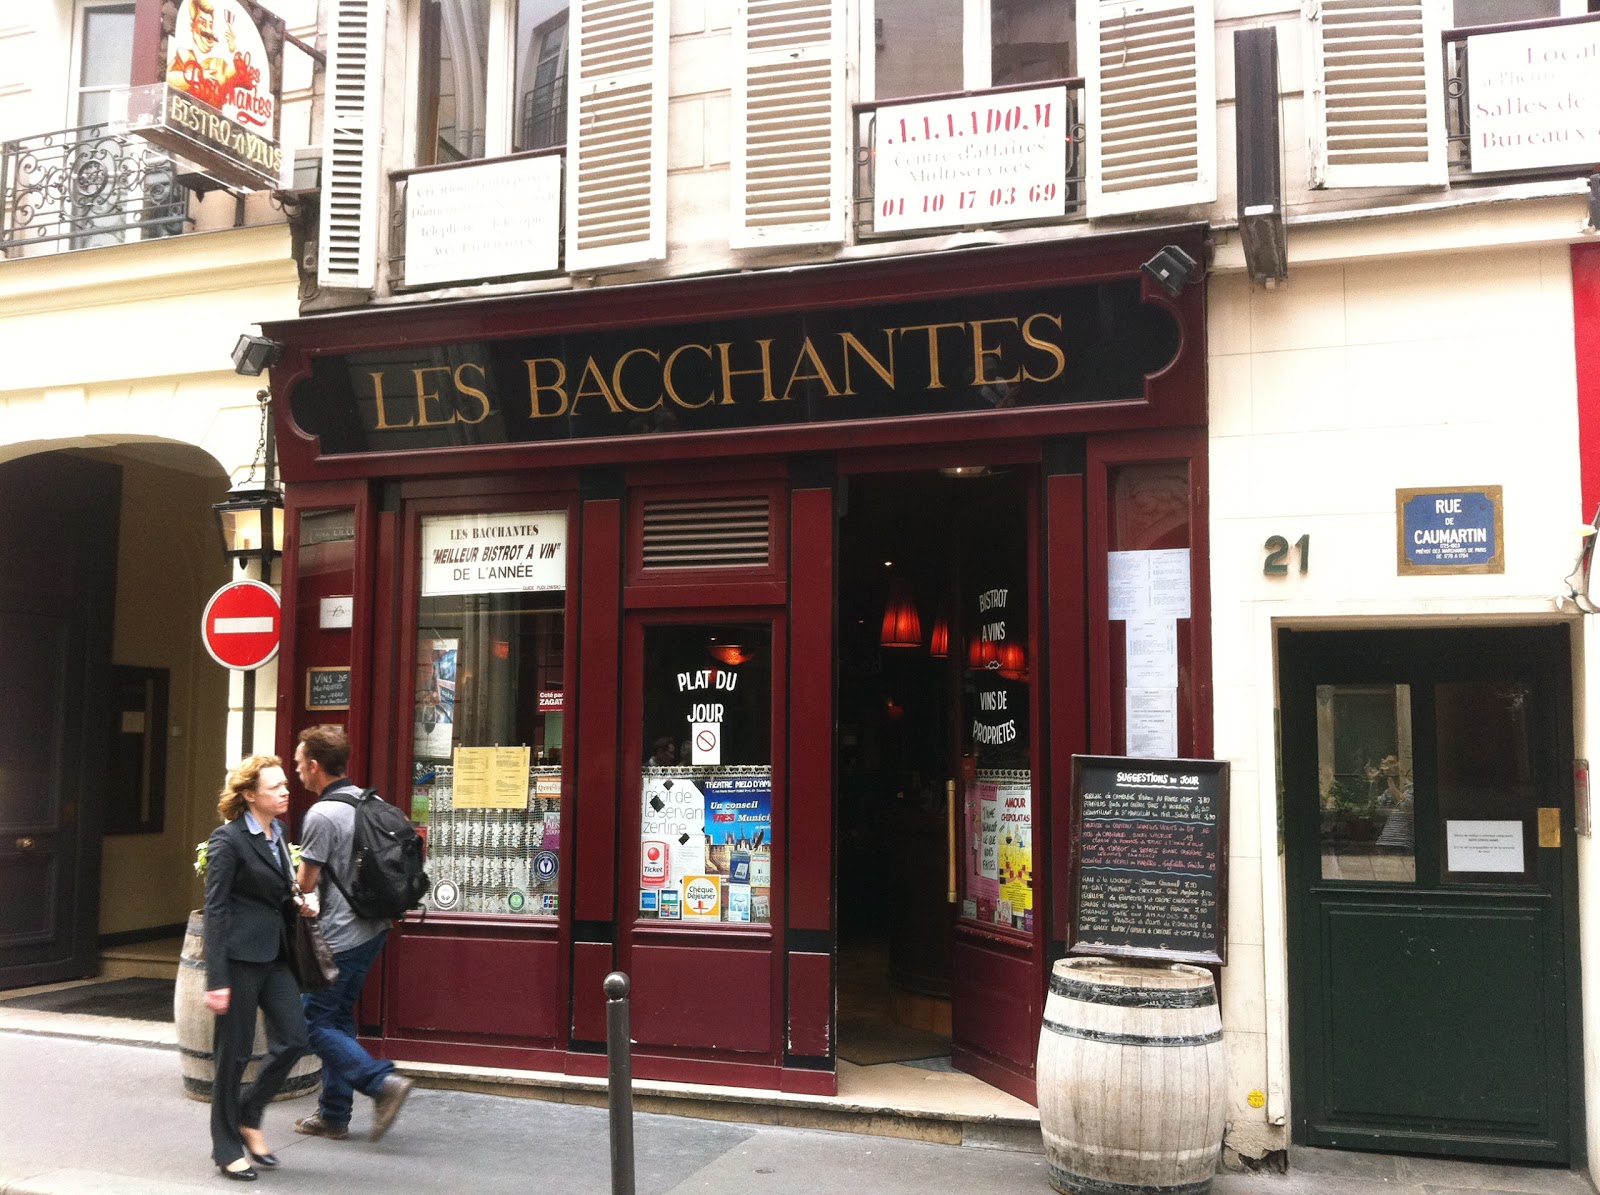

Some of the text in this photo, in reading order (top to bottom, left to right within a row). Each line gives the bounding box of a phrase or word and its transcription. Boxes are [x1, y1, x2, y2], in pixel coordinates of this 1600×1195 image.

[1477, 92, 1586, 118] Salles de
[1483, 128, 1586, 149] Bureaux
[895, 150, 952, 167] Centre
[882, 197, 905, 218] 01
[989, 186, 1017, 207] 03
[1029, 182, 1057, 203] 69
[370, 313, 1066, 430] LES BACCHANTES
[1435, 498, 1462, 514] RUE
[1444, 517, 1455, 526] DE
[450, 524, 539, 540] LES BACCHANTES
[1414, 528, 1487, 545] CAUMARTIN
[482, 544, 524, 562] BISTROT
[526, 544, 534, 560] A
[1263, 534, 1311, 576] 21
[453, 562, 534, 581] DE L'ANNÉE
[979, 589, 1008, 613] BISTROT
[987, 620, 1006, 642] VINS
[677, 669, 738, 692] PLAT DU
[539, 698, 564, 706] ZAGAT
[980, 690, 1008, 711] VINS DE
[687, 703, 724, 723] JOUR
[973, 719, 1016, 745] PROPRIETES
[1117, 772, 1169, 784] SUGGESTIONS
[1180, 775, 1200, 785] JOUR
[675, 788, 692, 803] de
[710, 800, 758, 809] Un conseil
[1005, 797, 1026, 808] AMOUR
[643, 819, 687, 835] zerline
[1001, 813, 1030, 823] CHIPOLATAS
